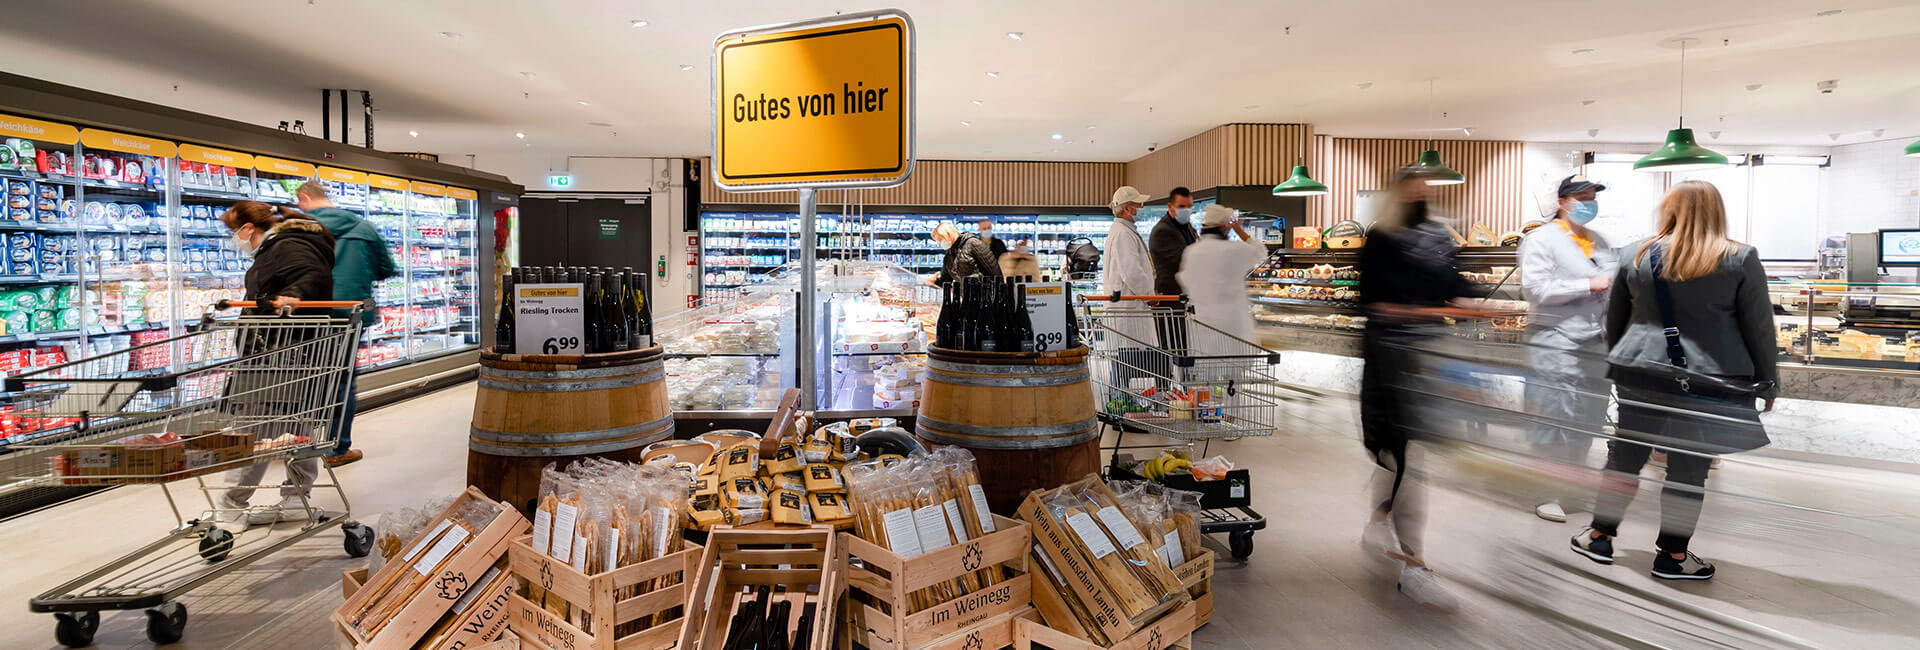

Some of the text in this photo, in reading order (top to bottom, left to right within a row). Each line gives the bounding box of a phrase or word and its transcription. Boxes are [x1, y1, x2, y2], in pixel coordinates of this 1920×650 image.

[733, 81, 889, 123] Gutes von hier
[112, 137, 151, 150] Weichkäse
[520, 306, 579, 315] Riesling Trocken
[1033, 506, 1050, 532] Wein
[1048, 530, 1063, 549] aus
[1060, 547, 1095, 592] deutschen
[1093, 590, 1120, 627] Landen
[463, 584, 513, 634] Weine
[482, 610, 510, 641] RHEING
[931, 585, 1010, 625] Im Weinegg
[522, 607, 575, 650] Im Weinegg
